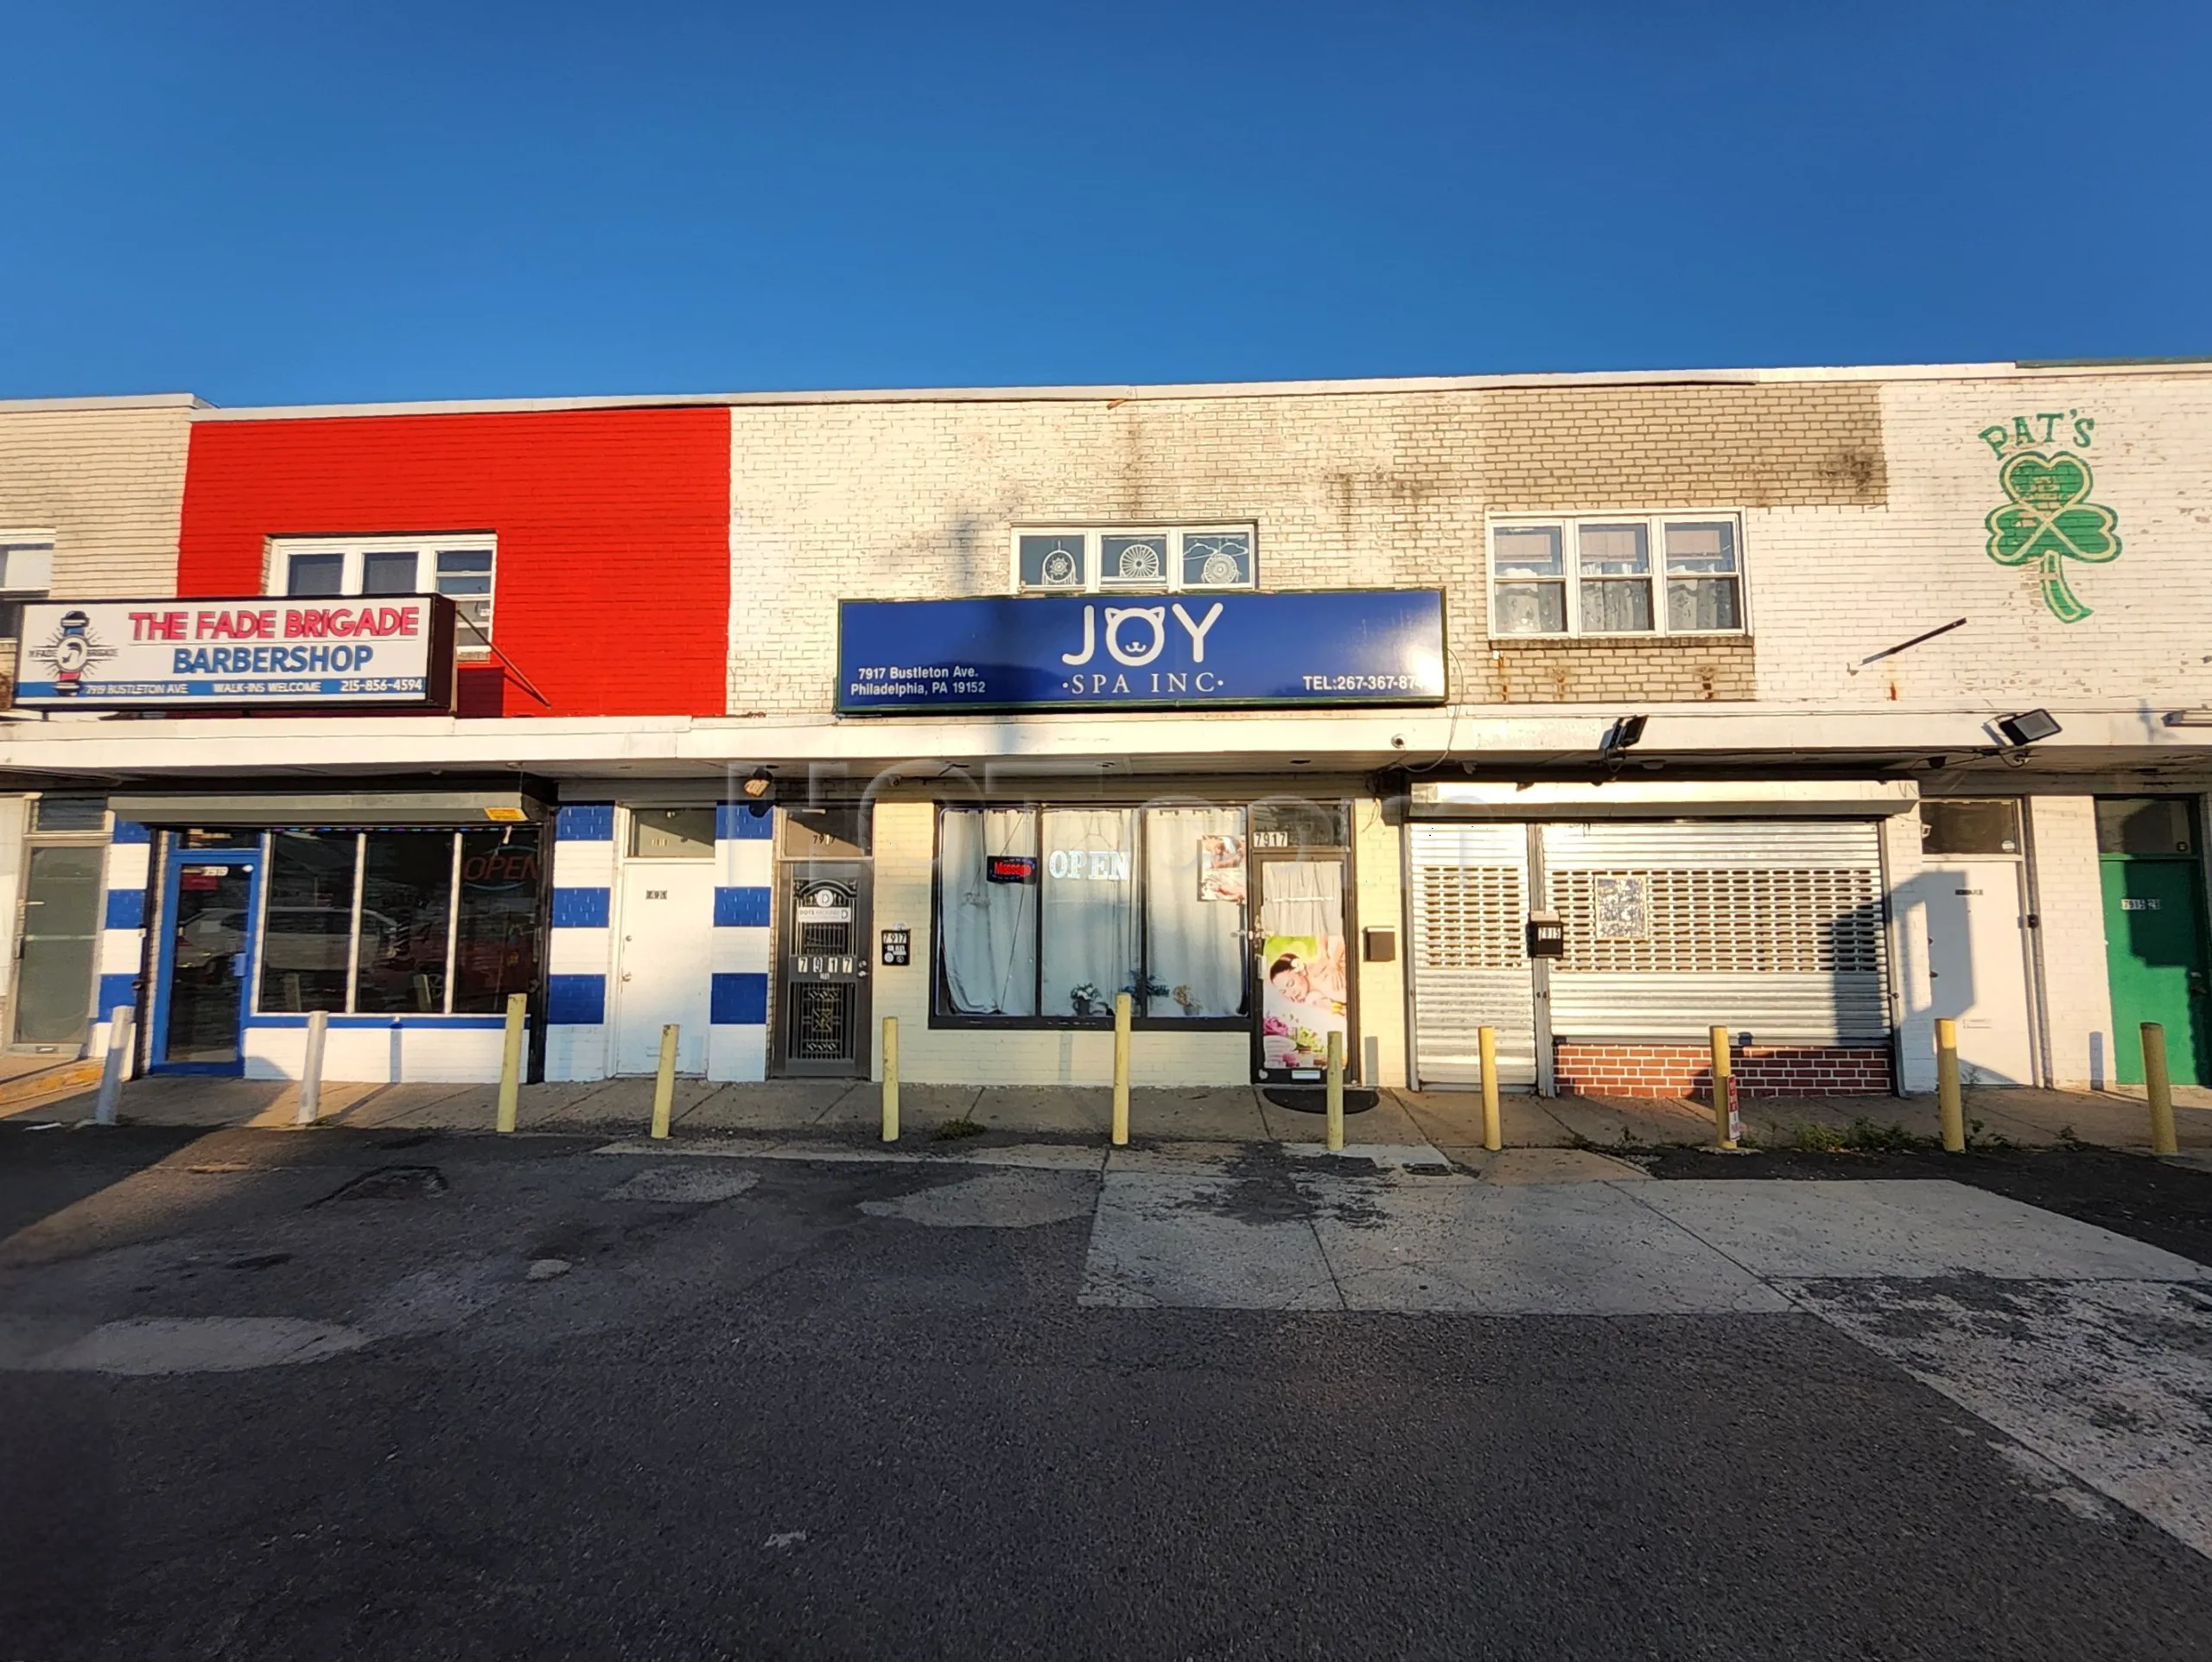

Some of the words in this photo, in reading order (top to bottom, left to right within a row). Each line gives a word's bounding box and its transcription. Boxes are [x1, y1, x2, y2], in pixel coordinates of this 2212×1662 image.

[1978, 408, 2094, 461] PAT'S
[128, 612, 188, 640] THE
[195, 609, 277, 640] FADE
[283, 607, 419, 638] BRIGADE
[1061, 602, 1224, 666] JOY
[172, 645, 374, 674] BARBERSHOP
[858, 667, 886, 679] 7917
[889, 666, 949, 679] Bustleton
[952, 665, 978, 678] Ave.
[167, 684, 189, 693] AVE
[268, 681, 322, 692] WELCOME
[340, 678, 423, 692] 215-856-4594
[850, 681, 928, 697] Philadelphia,
[932, 682, 948, 694] PA
[952, 681, 986, 693] 19152
[1255, 832, 1286, 846] 7917
[462, 856, 537, 881] OPEN
[1049, 850, 1130, 881] OPEN
[883, 933, 906, 944] 7917
[799, 957, 853, 973] 7917
